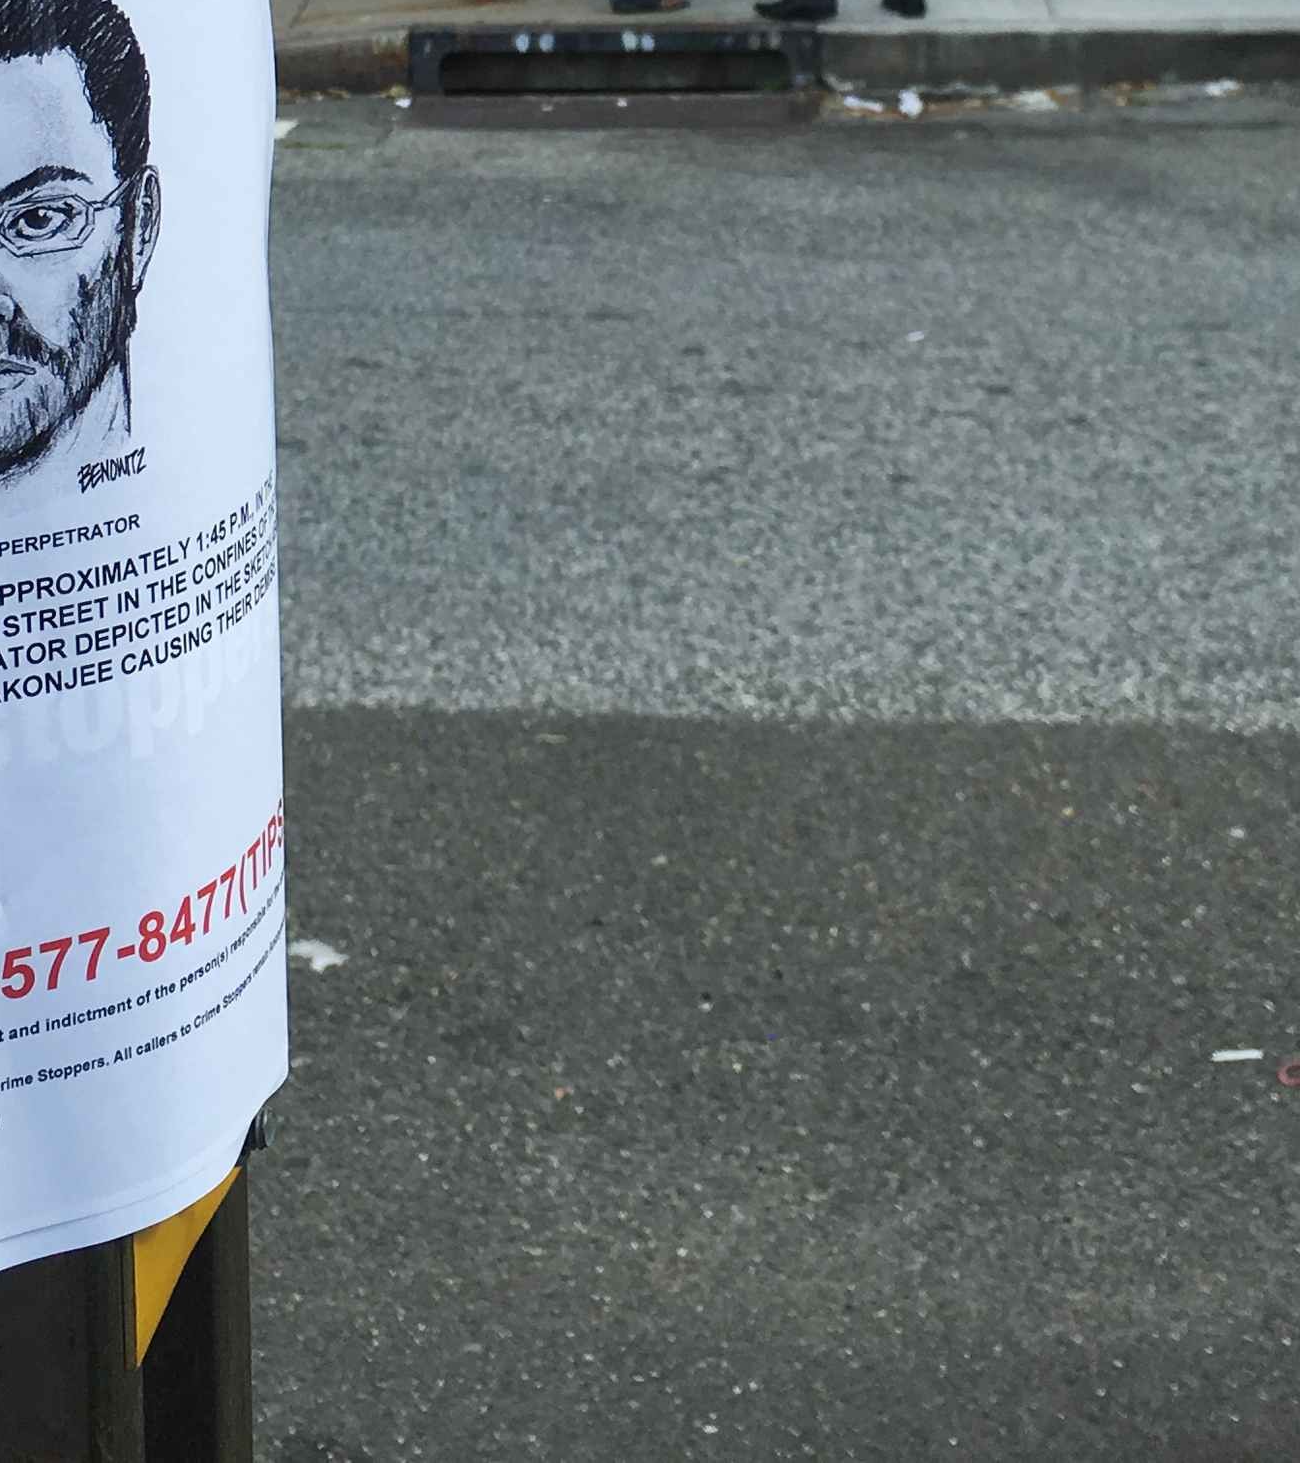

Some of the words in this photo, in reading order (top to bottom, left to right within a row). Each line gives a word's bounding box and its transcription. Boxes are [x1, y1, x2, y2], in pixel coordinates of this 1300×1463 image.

[196, 519, 227, 552] 1:45
[2, 596, 109, 639] STREET
[117, 587, 140, 615] IN
[146, 570, 188, 604] THE
[192, 525, 258, 586] CONFINES
[75, 600, 191, 656] DEPICTED
[195, 589, 213, 617] IN
[214, 570, 242, 604] THE
[120, 620, 214, 676] CAUSING
[216, 592, 253, 635] THEIR
[8, 1020, 41, 1040] and
[45, 997, 133, 1032] indictment
[136, 989, 152, 1007] of
[154, 982, 177, 1000] the
[179, 945, 230, 992] person(s)
[37, 1055, 110, 1083] Stoppers.
[113, 1046, 133, 1064] All
[136, 1029, 179, 1057] callers
[179, 1022, 192, 1039] to
[193, 1002, 222, 1031] Crime
